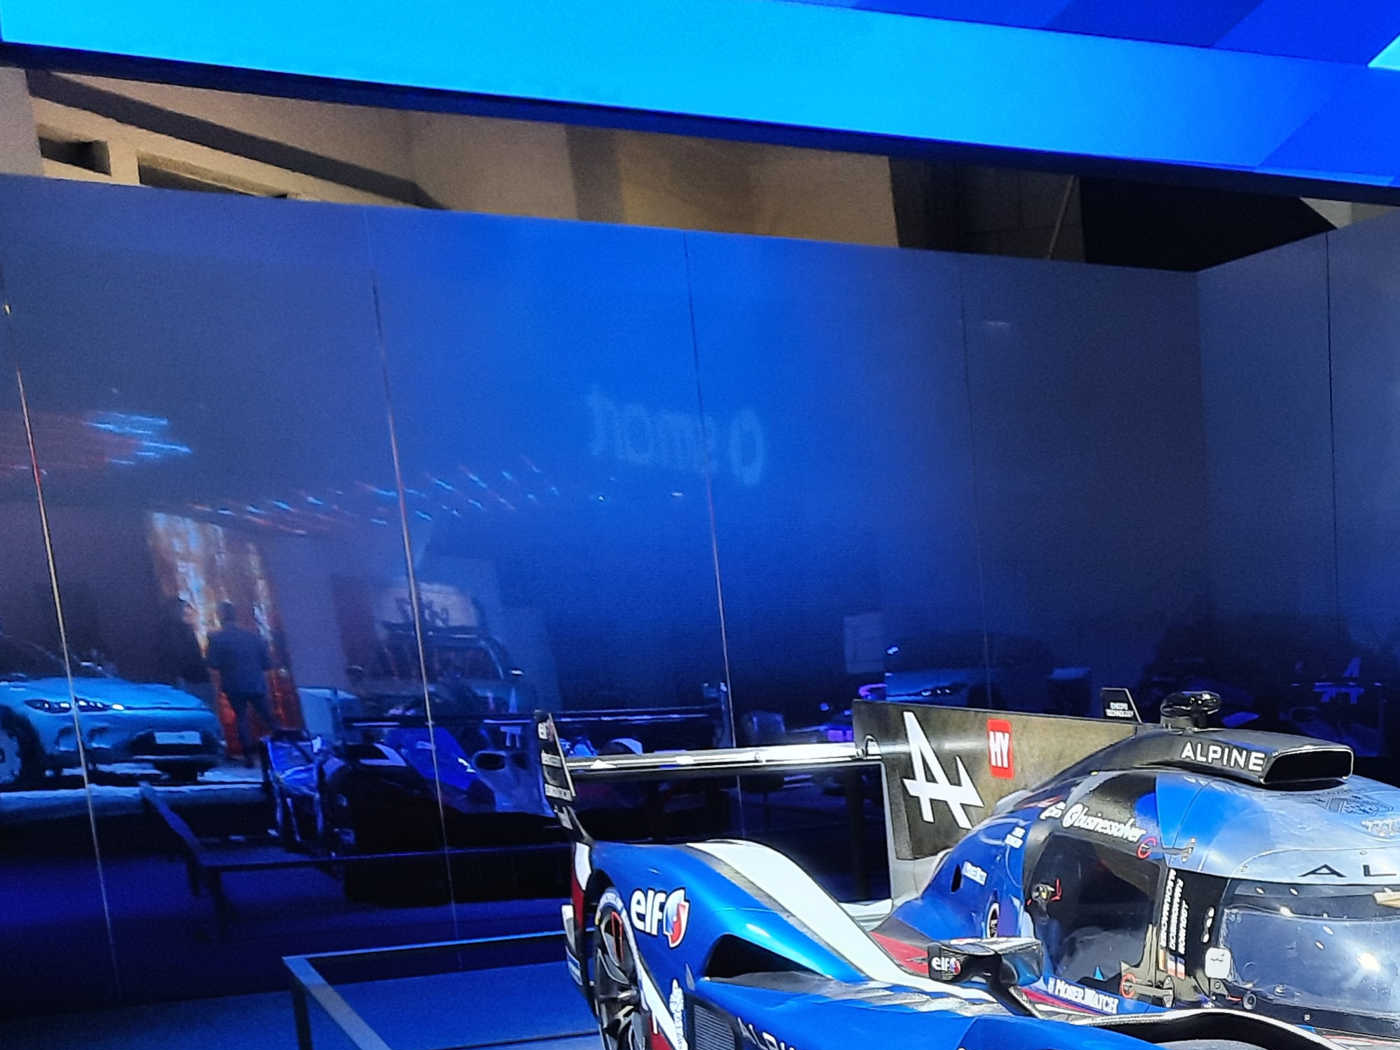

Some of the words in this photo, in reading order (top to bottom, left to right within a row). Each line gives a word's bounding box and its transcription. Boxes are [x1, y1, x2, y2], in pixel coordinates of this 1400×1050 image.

[988, 731, 1010, 768] HY
[1181, 741, 1266, 771] ALPINE
[1076, 803, 1147, 843] businessolver
